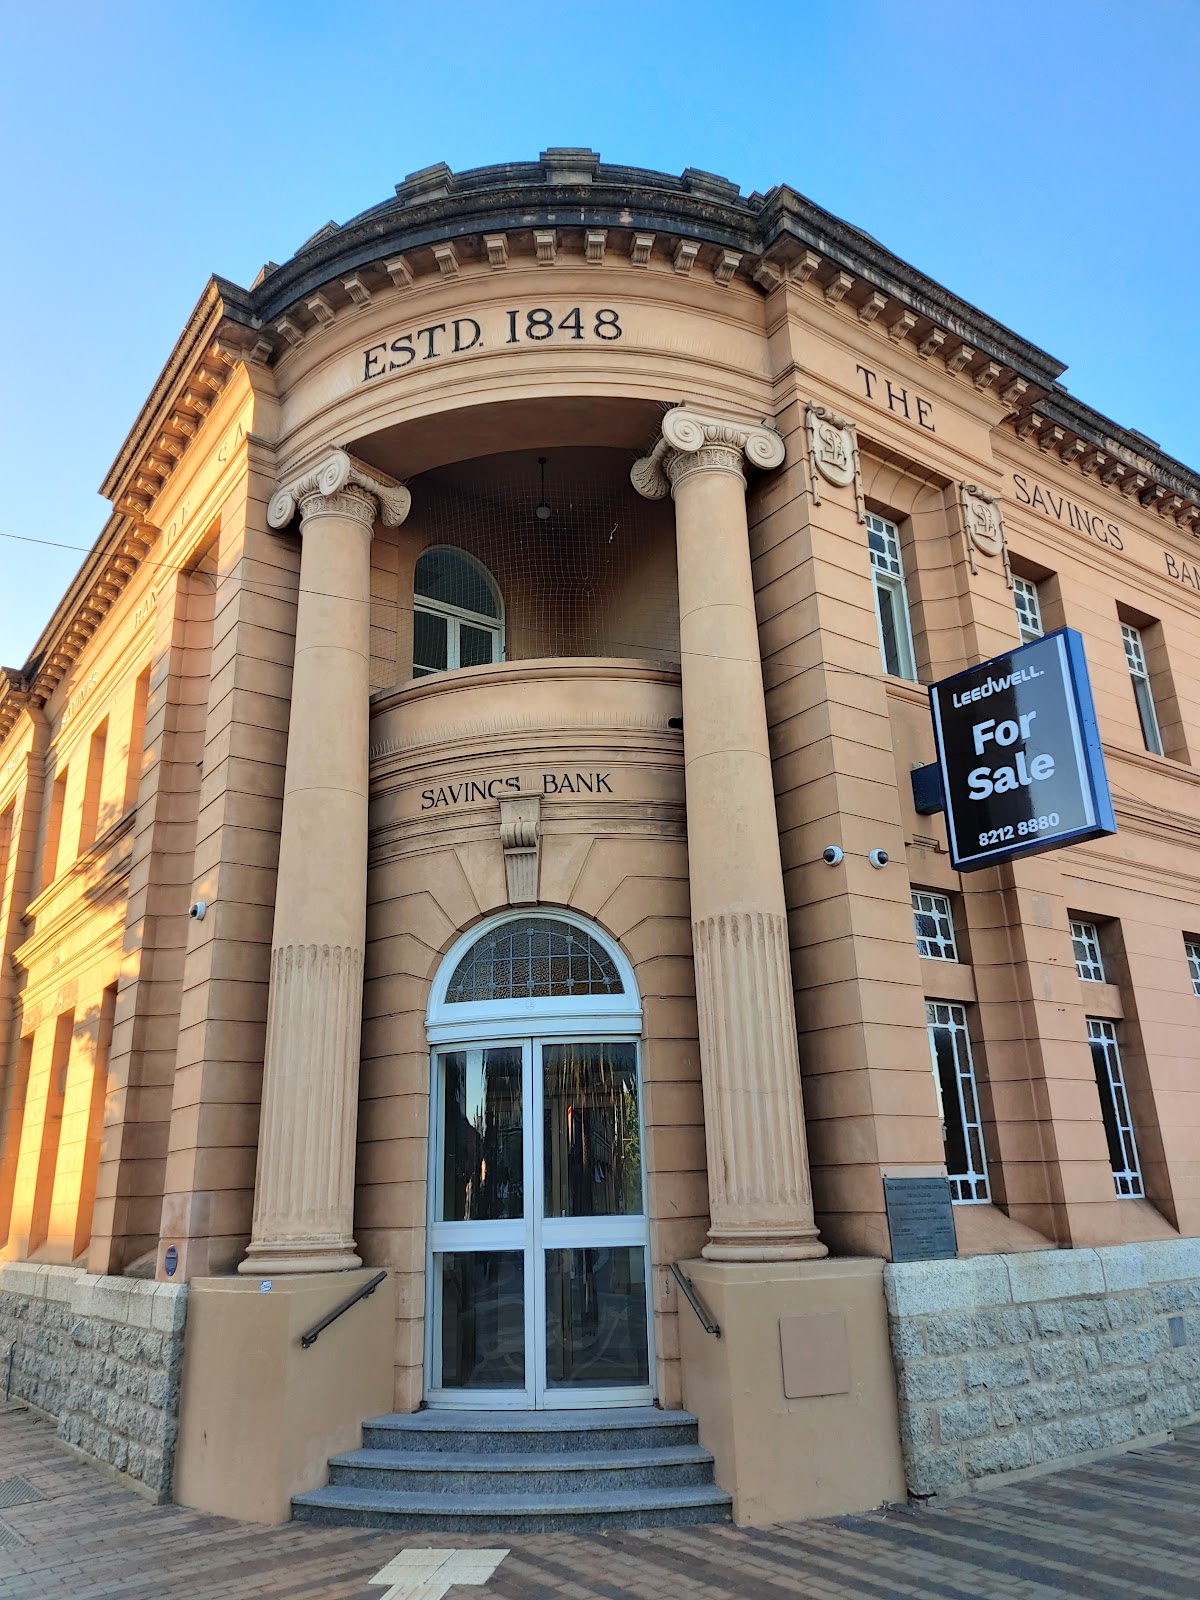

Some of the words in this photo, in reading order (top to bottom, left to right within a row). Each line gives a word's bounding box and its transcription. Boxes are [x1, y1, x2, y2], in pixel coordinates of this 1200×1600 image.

[361, 317, 485, 383] ESTD.
[506, 306, 623, 344] 1848
[856, 364, 936, 433] THE
[1012, 473, 1124, 552] SAVINGS
[1163, 551, 1200, 590] BAN
[972, 710, 1037, 756] For
[541, 772, 614, 794] BANK
[967, 750, 1055, 801] Sale
[978, 825, 1016, 847] 8212
[1017, 812, 1060, 837] 8880
